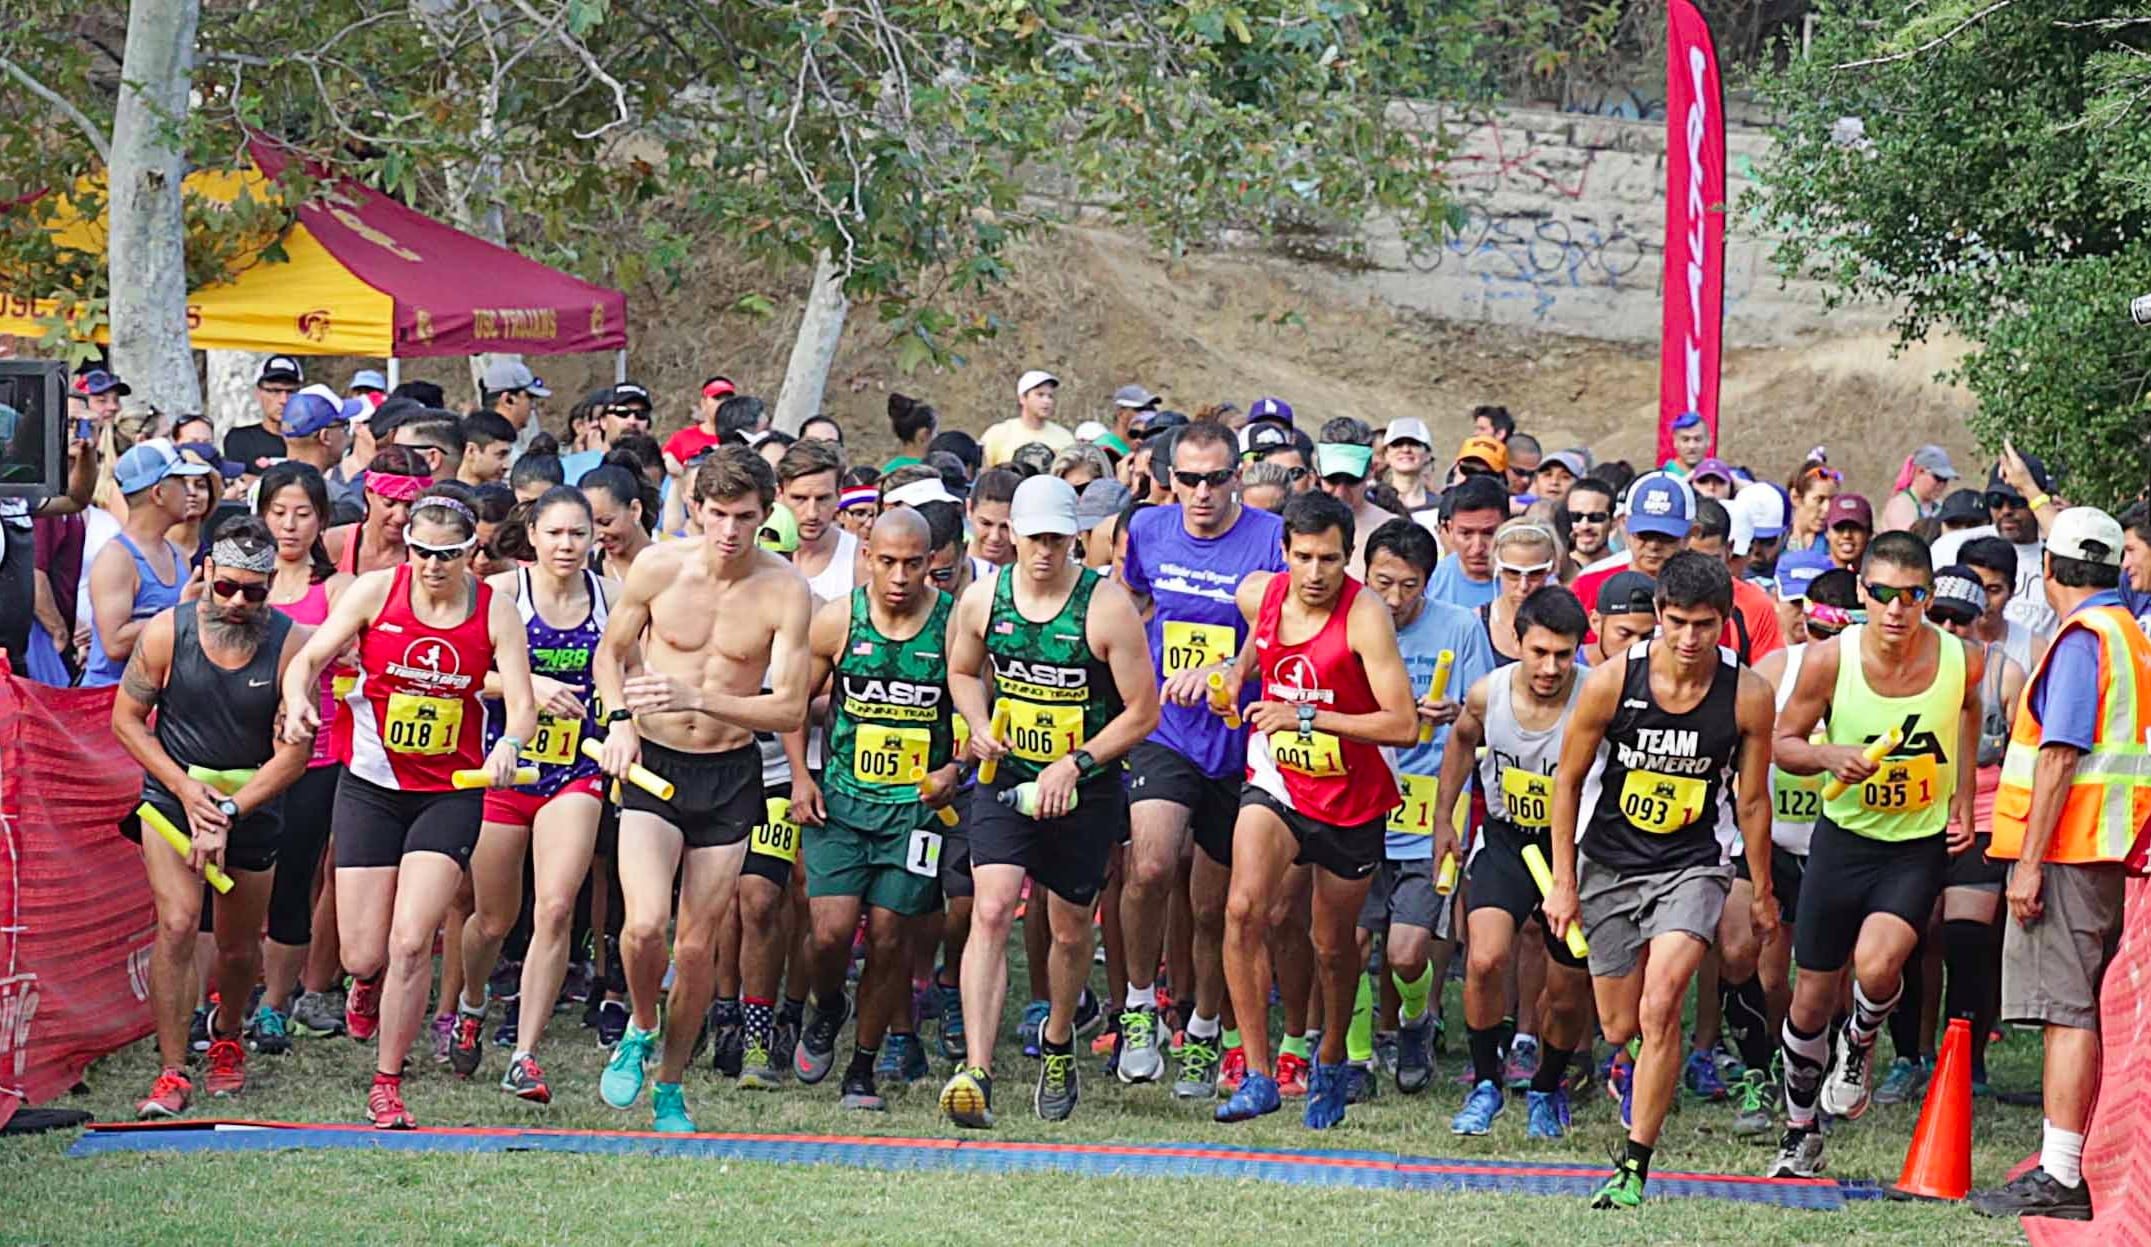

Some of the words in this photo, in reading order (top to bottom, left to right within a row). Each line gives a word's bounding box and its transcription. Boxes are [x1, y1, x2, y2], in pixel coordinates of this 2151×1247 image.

[472, 309, 498, 338] USC
[499, 308, 557, 338] TROJANS
[989, 653, 1087, 688] LASD
[1169, 646, 1205, 669] 072
[843, 677, 942, 707] LASD
[1050, 689, 1086, 699] TEAM
[390, 720, 432, 748] 018
[442, 723, 454, 747] 1
[558, 731, 571, 757] 1
[1016, 726, 1053, 755] 006
[1065, 731, 1075, 754] 1
[1636, 728, 1699, 758] TEAM
[860, 750, 899, 777] 005
[911, 752, 921, 767] 1
[1276, 747, 1315, 772] 001
[1324, 752, 1337, 772] 1
[1617, 742, 1713, 774] ROMERO
[1778, 789, 1818, 816] 122
[1864, 783, 1907, 807] 035
[1919, 778, 1931, 803] 1
[1416, 801, 1428, 827] 1
[1508, 793, 1546, 821] 060
[1625, 793, 1669, 825] 093
[1682, 807, 1693, 825] 1
[758, 823, 793, 851] 088
[916, 835, 931, 868] 1
